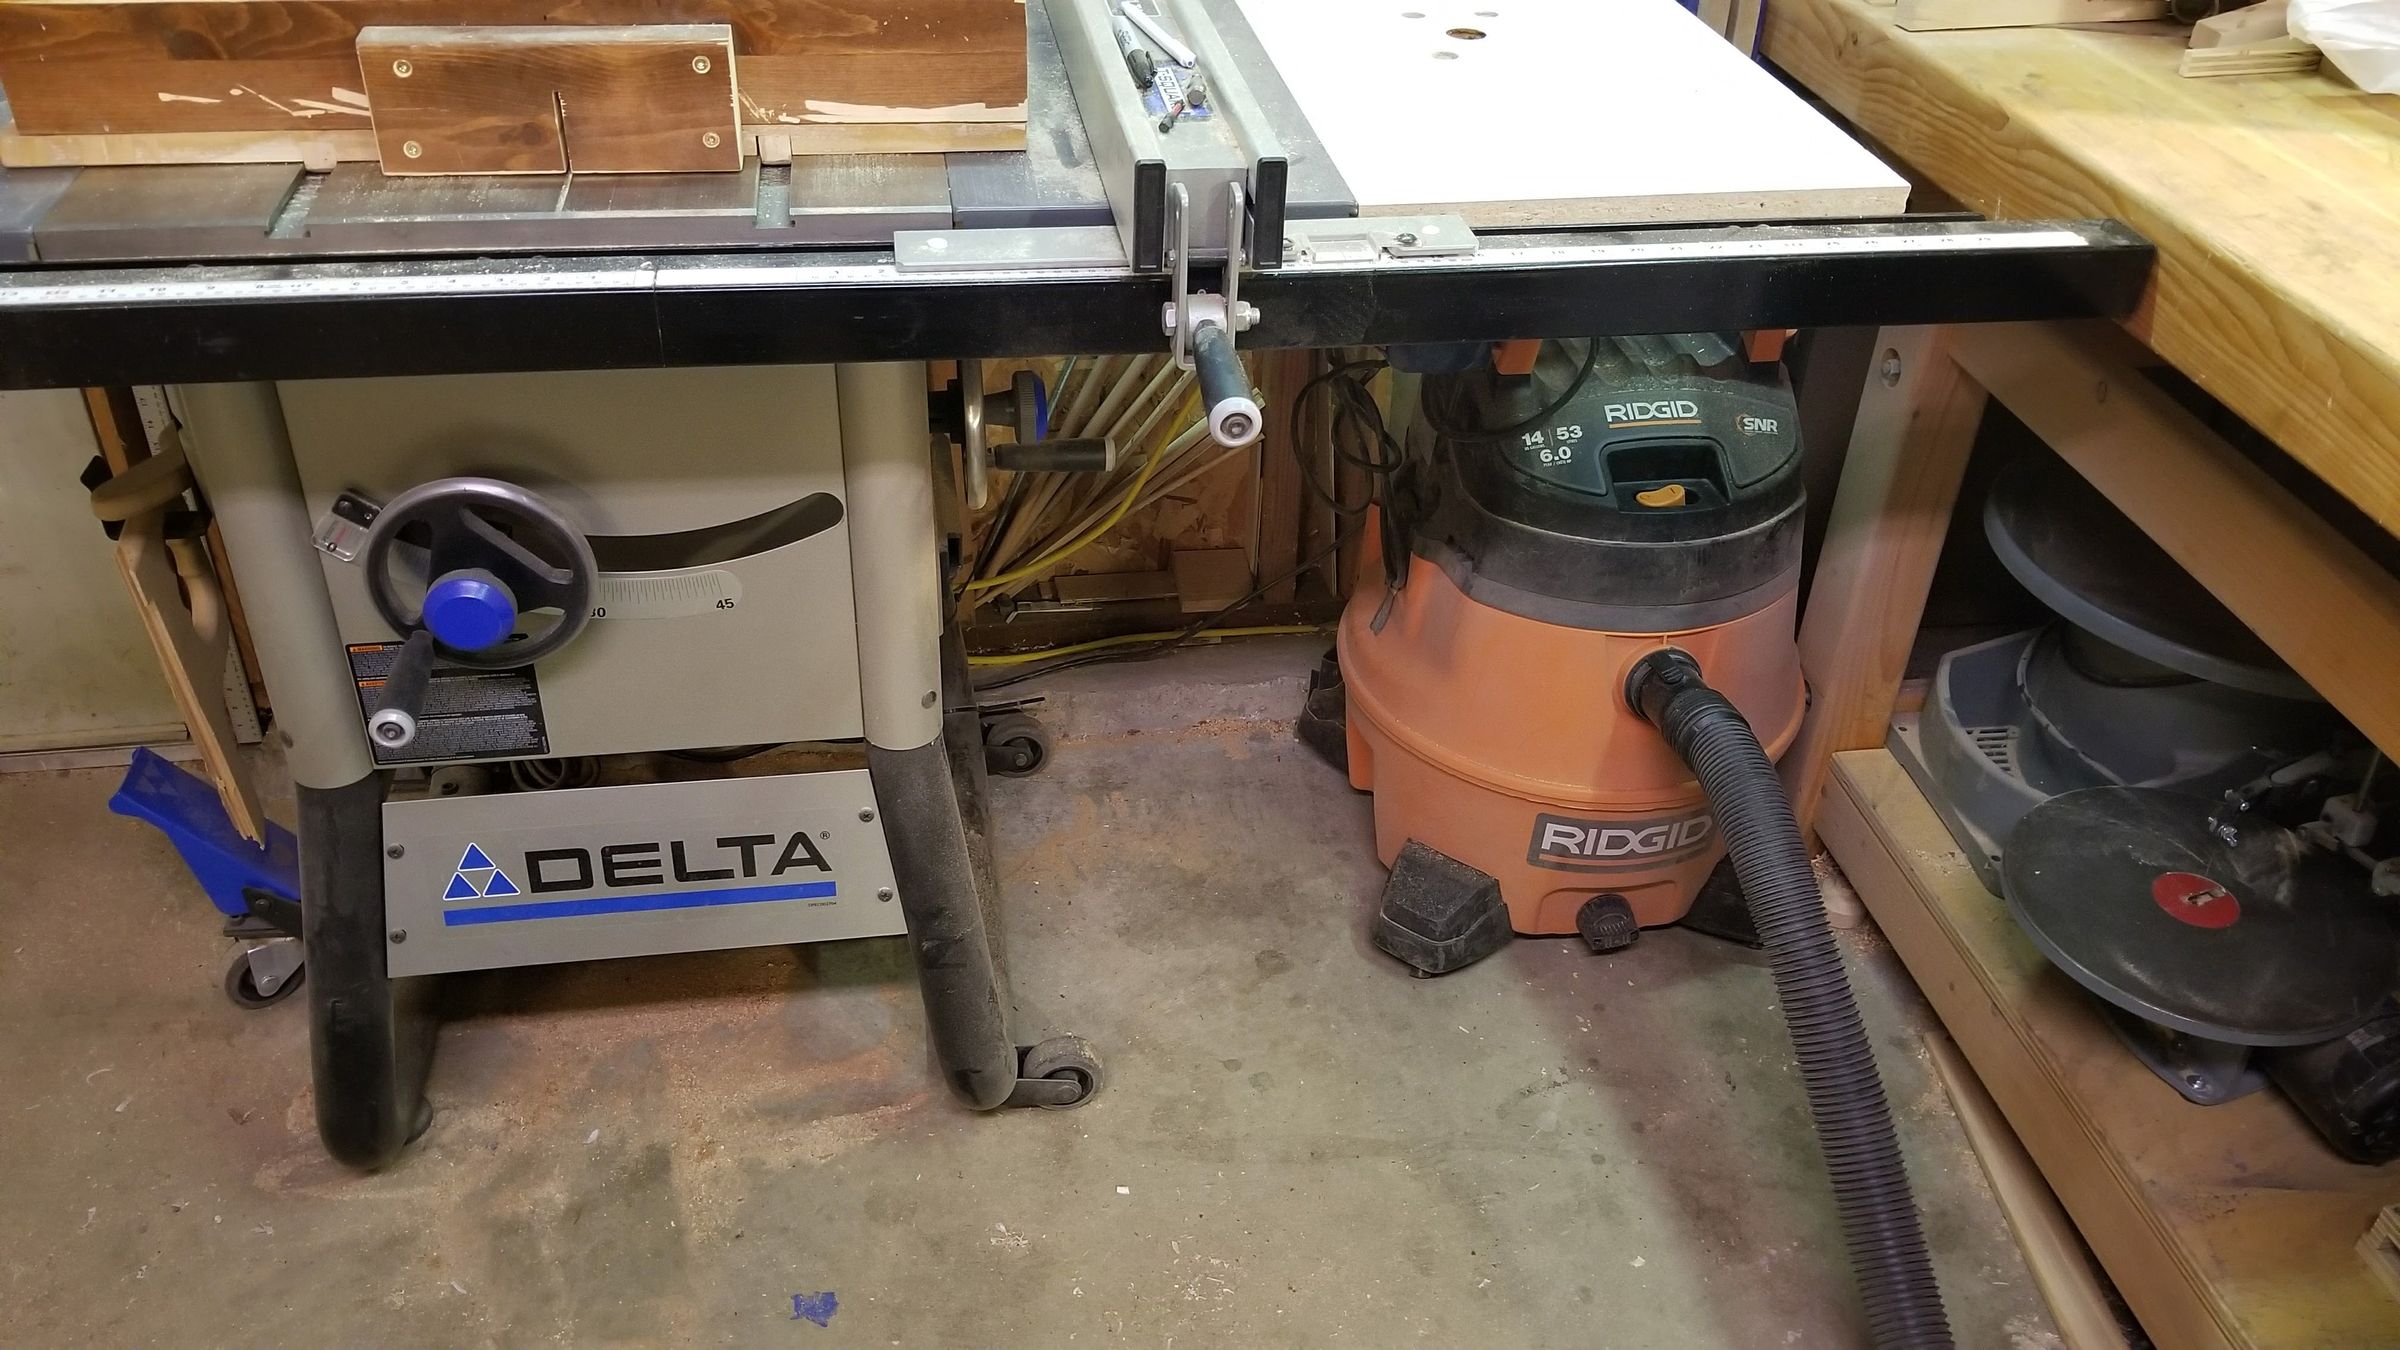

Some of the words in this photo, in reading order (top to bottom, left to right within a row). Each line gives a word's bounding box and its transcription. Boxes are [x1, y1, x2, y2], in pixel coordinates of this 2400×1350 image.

[1604, 400, 1699, 422] RIDGID
[1743, 417, 1778, 433] SNR
[1521, 430, 1545, 446] 14
[1556, 424, 1583, 440] 53
[1539, 446, 1572, 463] 6.0
[716, 597, 735, 611] 45
[1541, 815, 1713, 856] RIDGID
